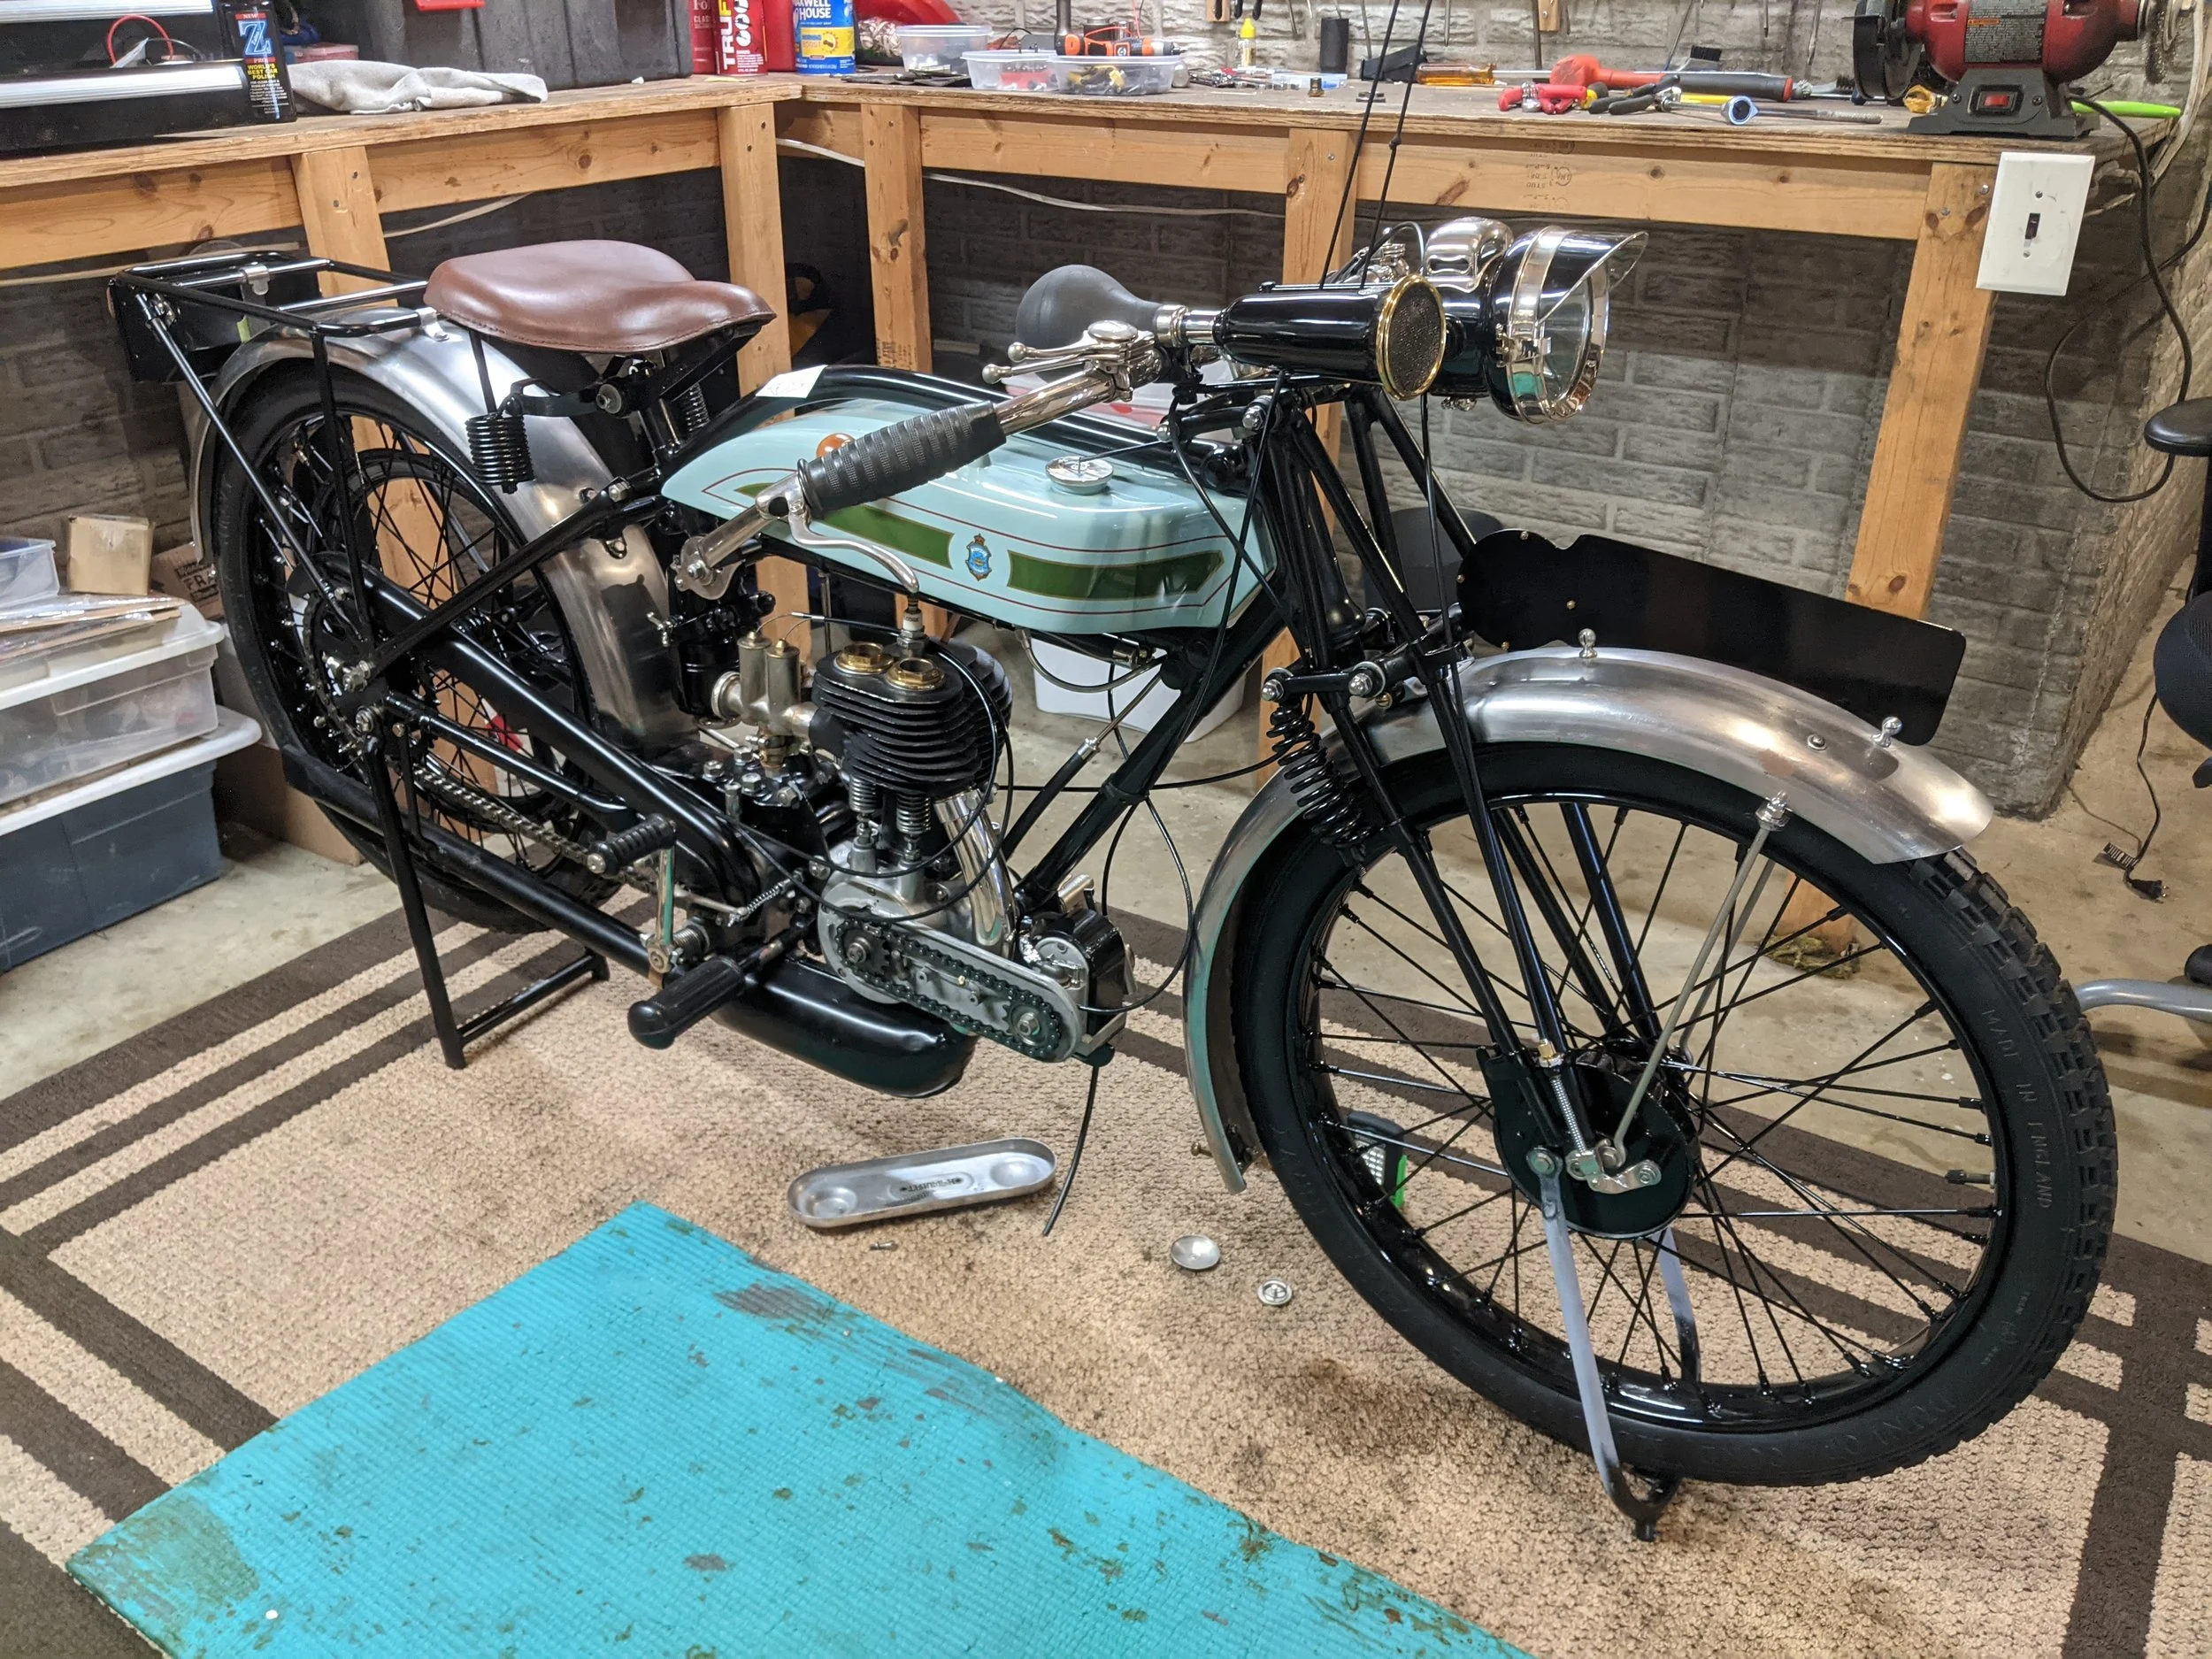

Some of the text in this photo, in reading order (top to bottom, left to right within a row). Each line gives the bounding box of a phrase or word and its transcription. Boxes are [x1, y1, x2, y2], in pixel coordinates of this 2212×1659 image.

[799, 7, 832, 20] HOUSE
[237, 20, 272, 55] Z
[2016, 1083, 2038, 1102] IN
